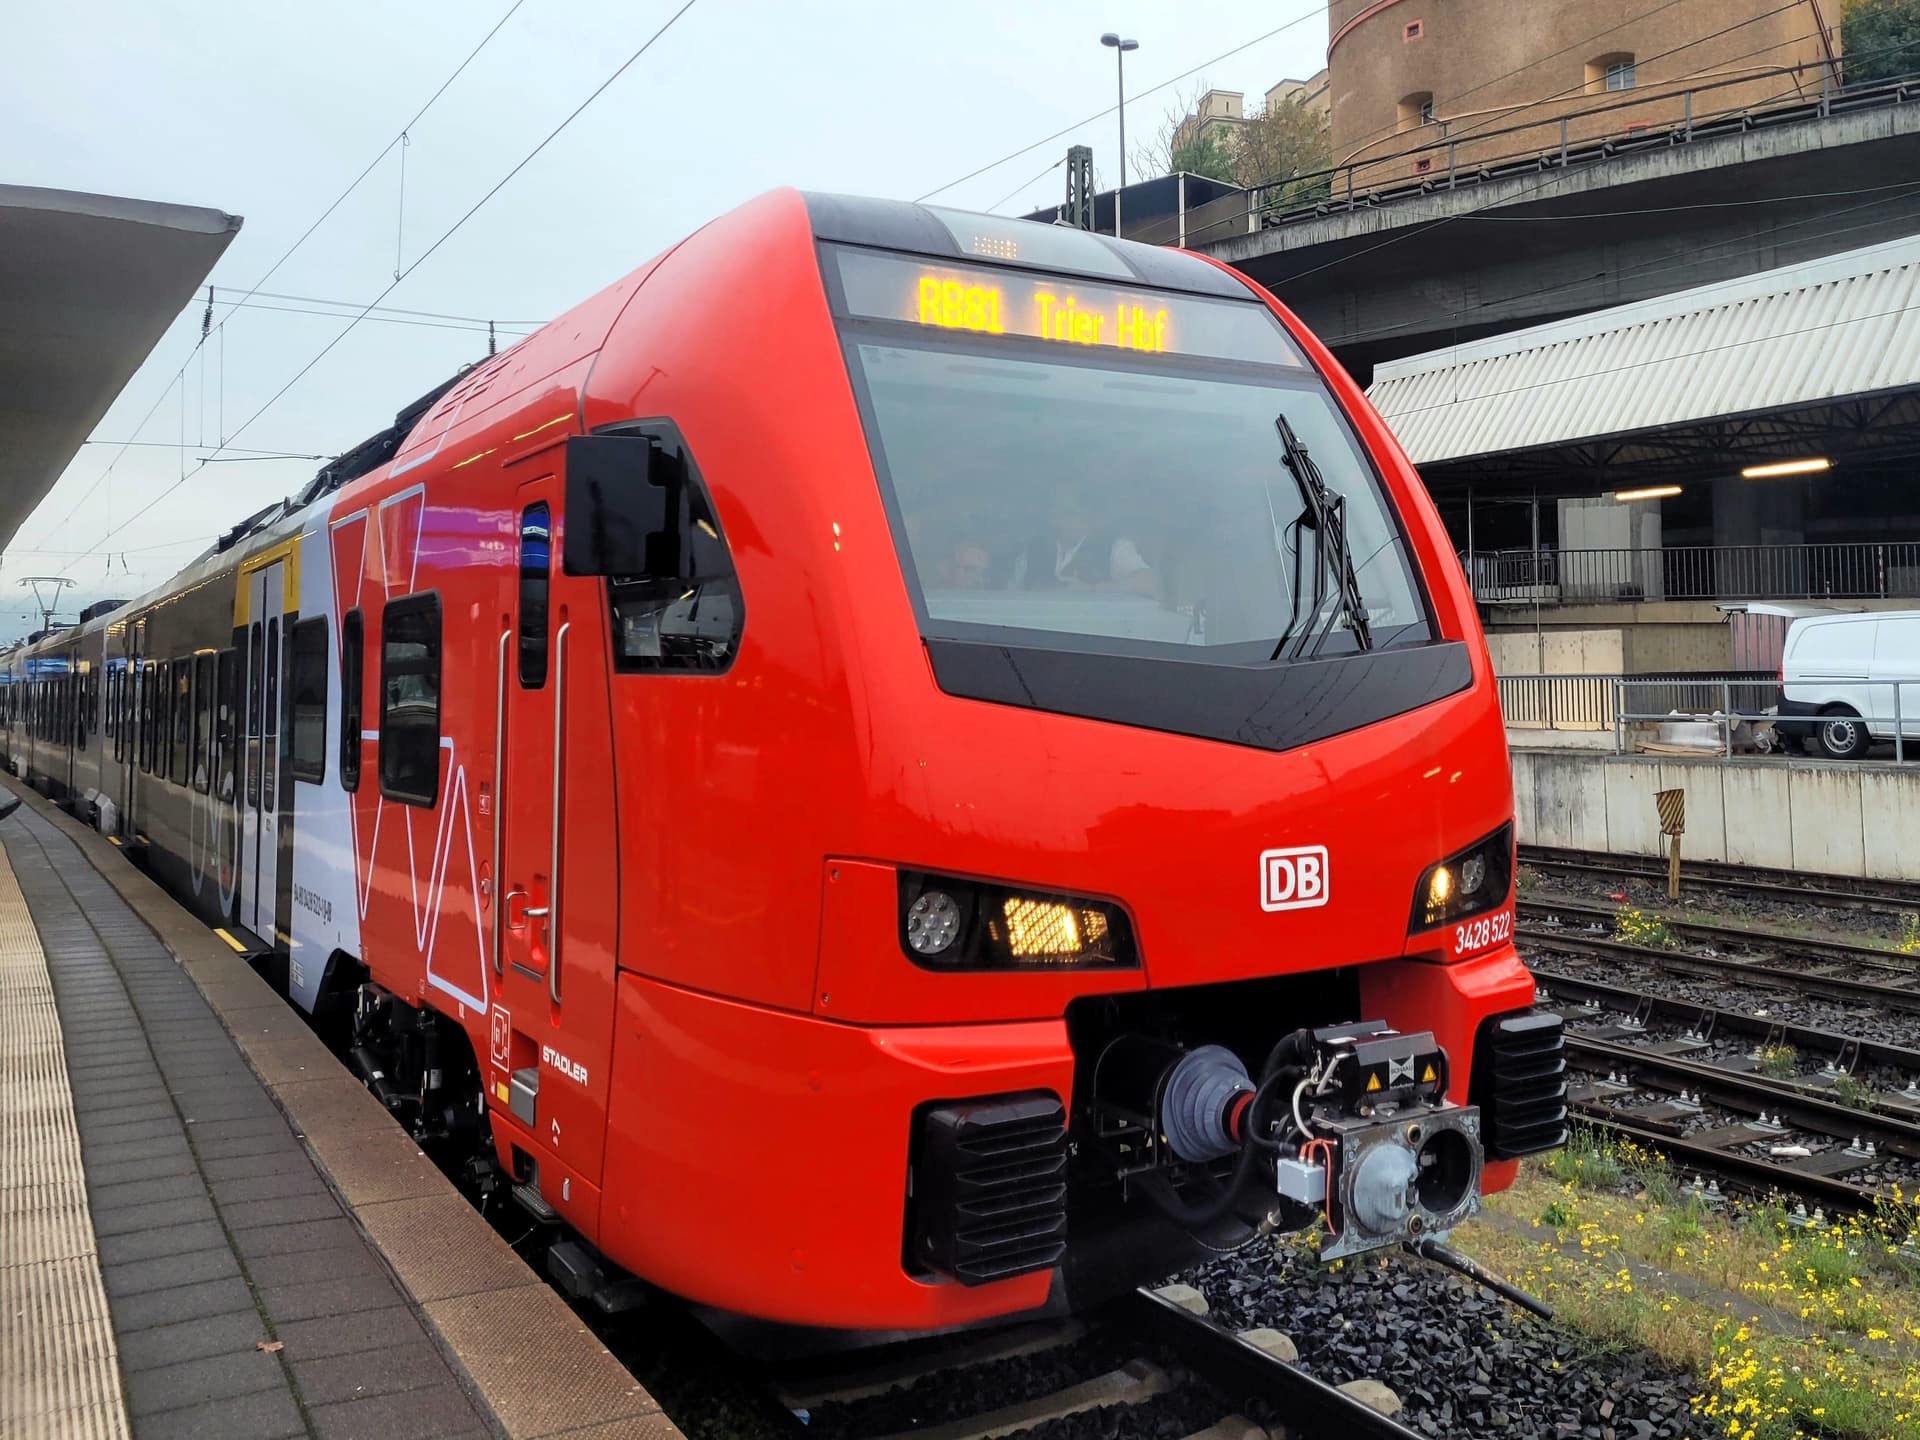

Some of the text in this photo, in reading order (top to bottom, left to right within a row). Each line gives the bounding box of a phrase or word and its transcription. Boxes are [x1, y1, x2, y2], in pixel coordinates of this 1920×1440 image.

[919, 277, 1168, 352] RB81 Trier Hbf
[1269, 856, 1321, 902] DB
[1455, 911, 1511, 954] 3428 522
[542, 1045, 588, 1087] STADLER
